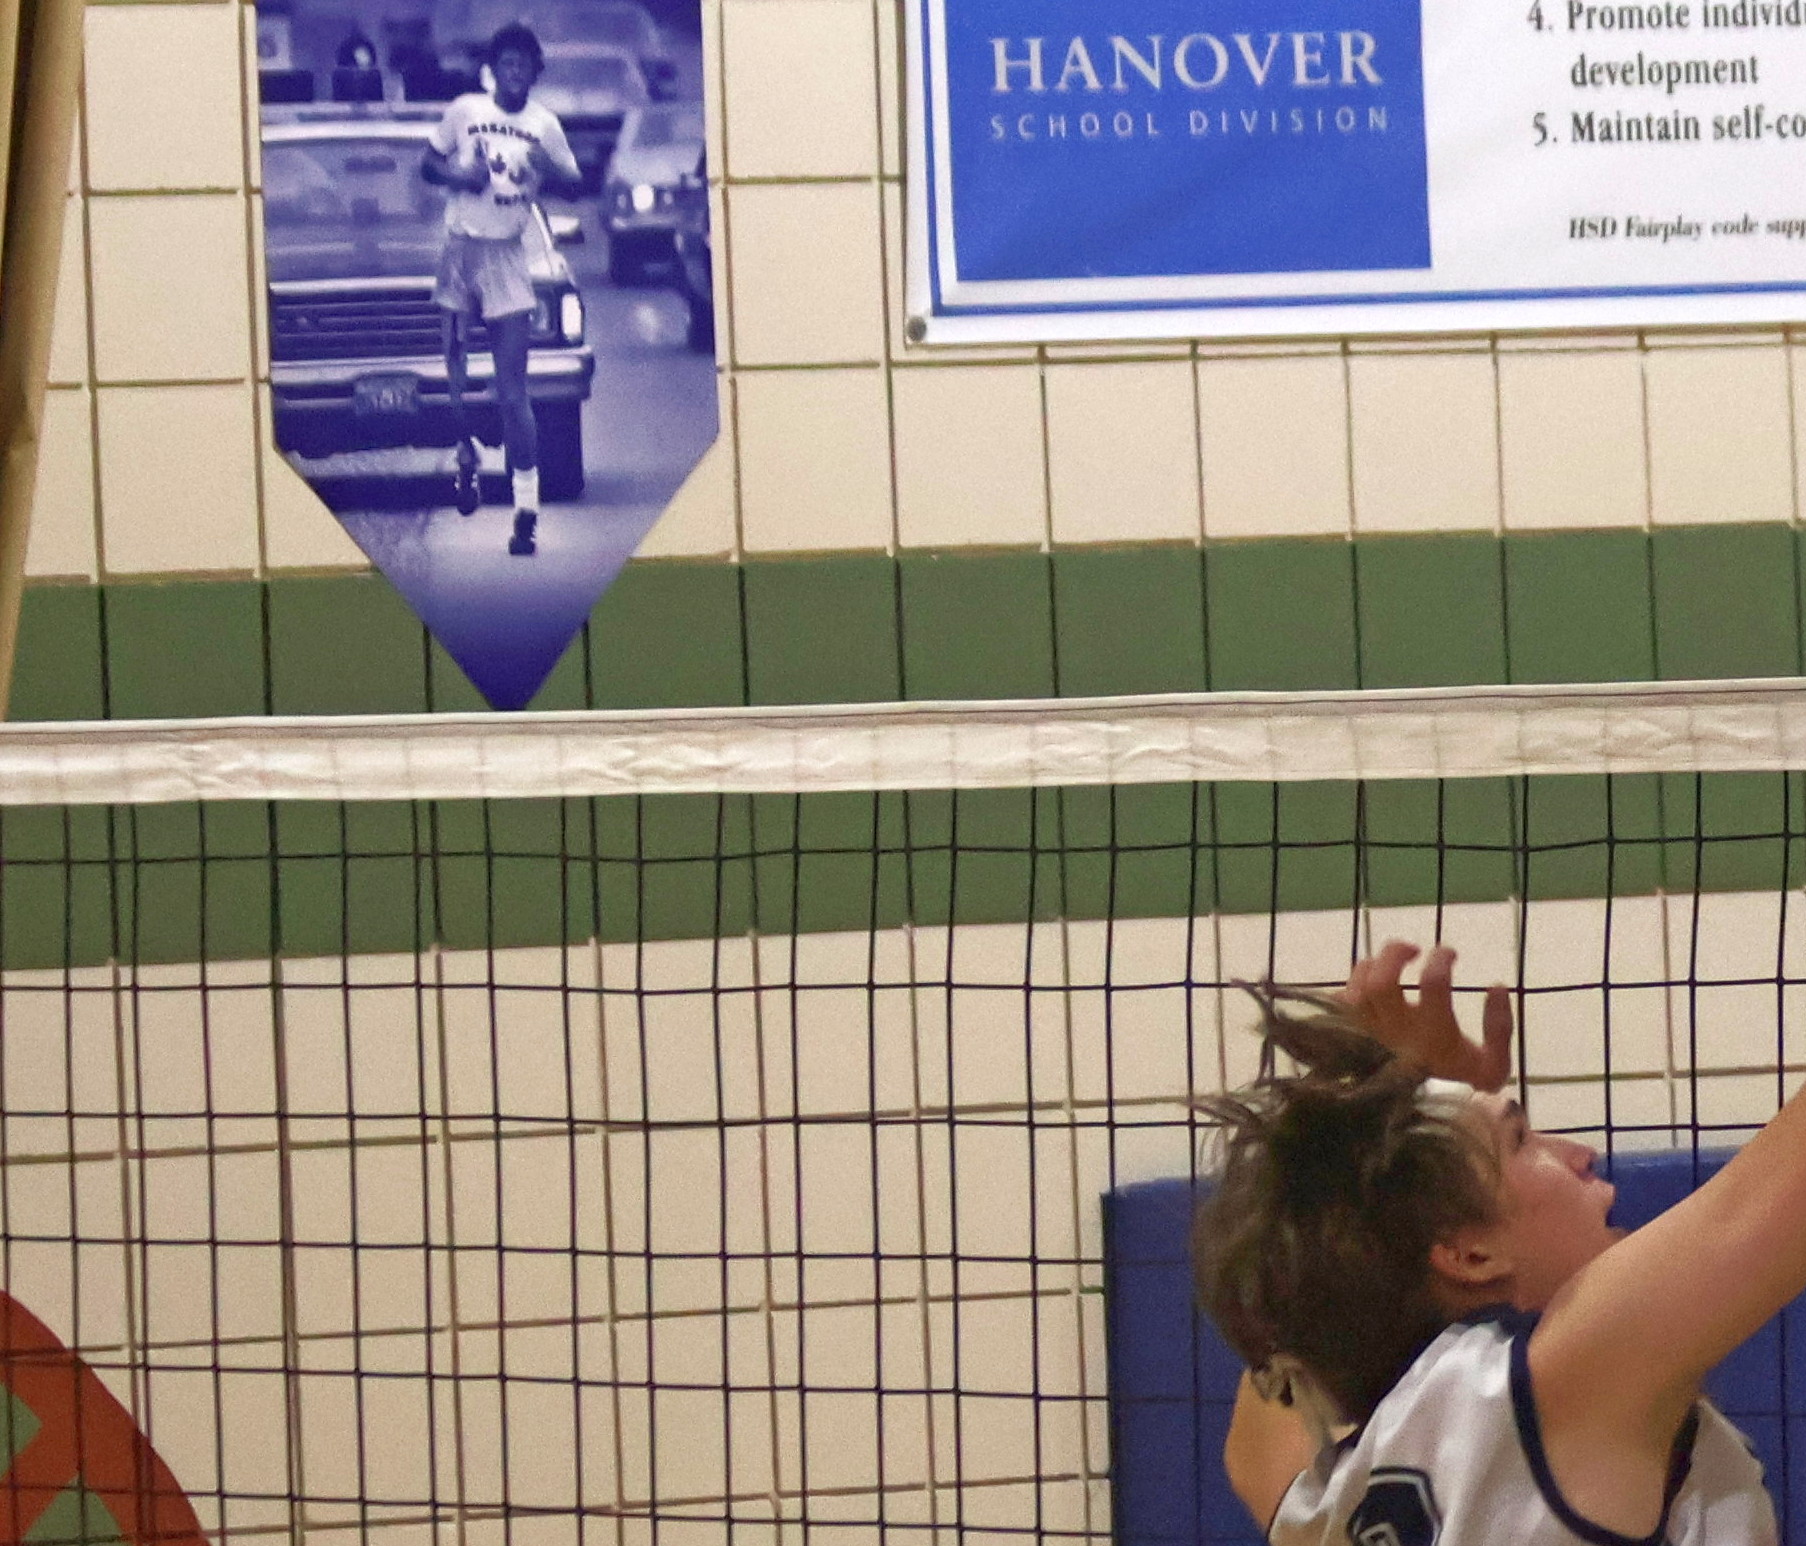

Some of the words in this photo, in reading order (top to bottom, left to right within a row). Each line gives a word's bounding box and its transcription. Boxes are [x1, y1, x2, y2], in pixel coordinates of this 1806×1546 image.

[1527, 0, 1552, 31] 4.
[1567, 0, 1691, 31] Promote
[990, 30, 1384, 94] HANOVER
[1570, 52, 1760, 96] development
[990, 111, 1161, 141] SCHOOL
[1189, 106, 1390, 137] DIVISION
[1533, 111, 1559, 147] 5.
[1572, 109, 1702, 144] Maintain
[1569, 216, 1618, 240] HSD
[1625, 212, 1703, 244] Fairplay
[1711, 212, 1760, 236] code
